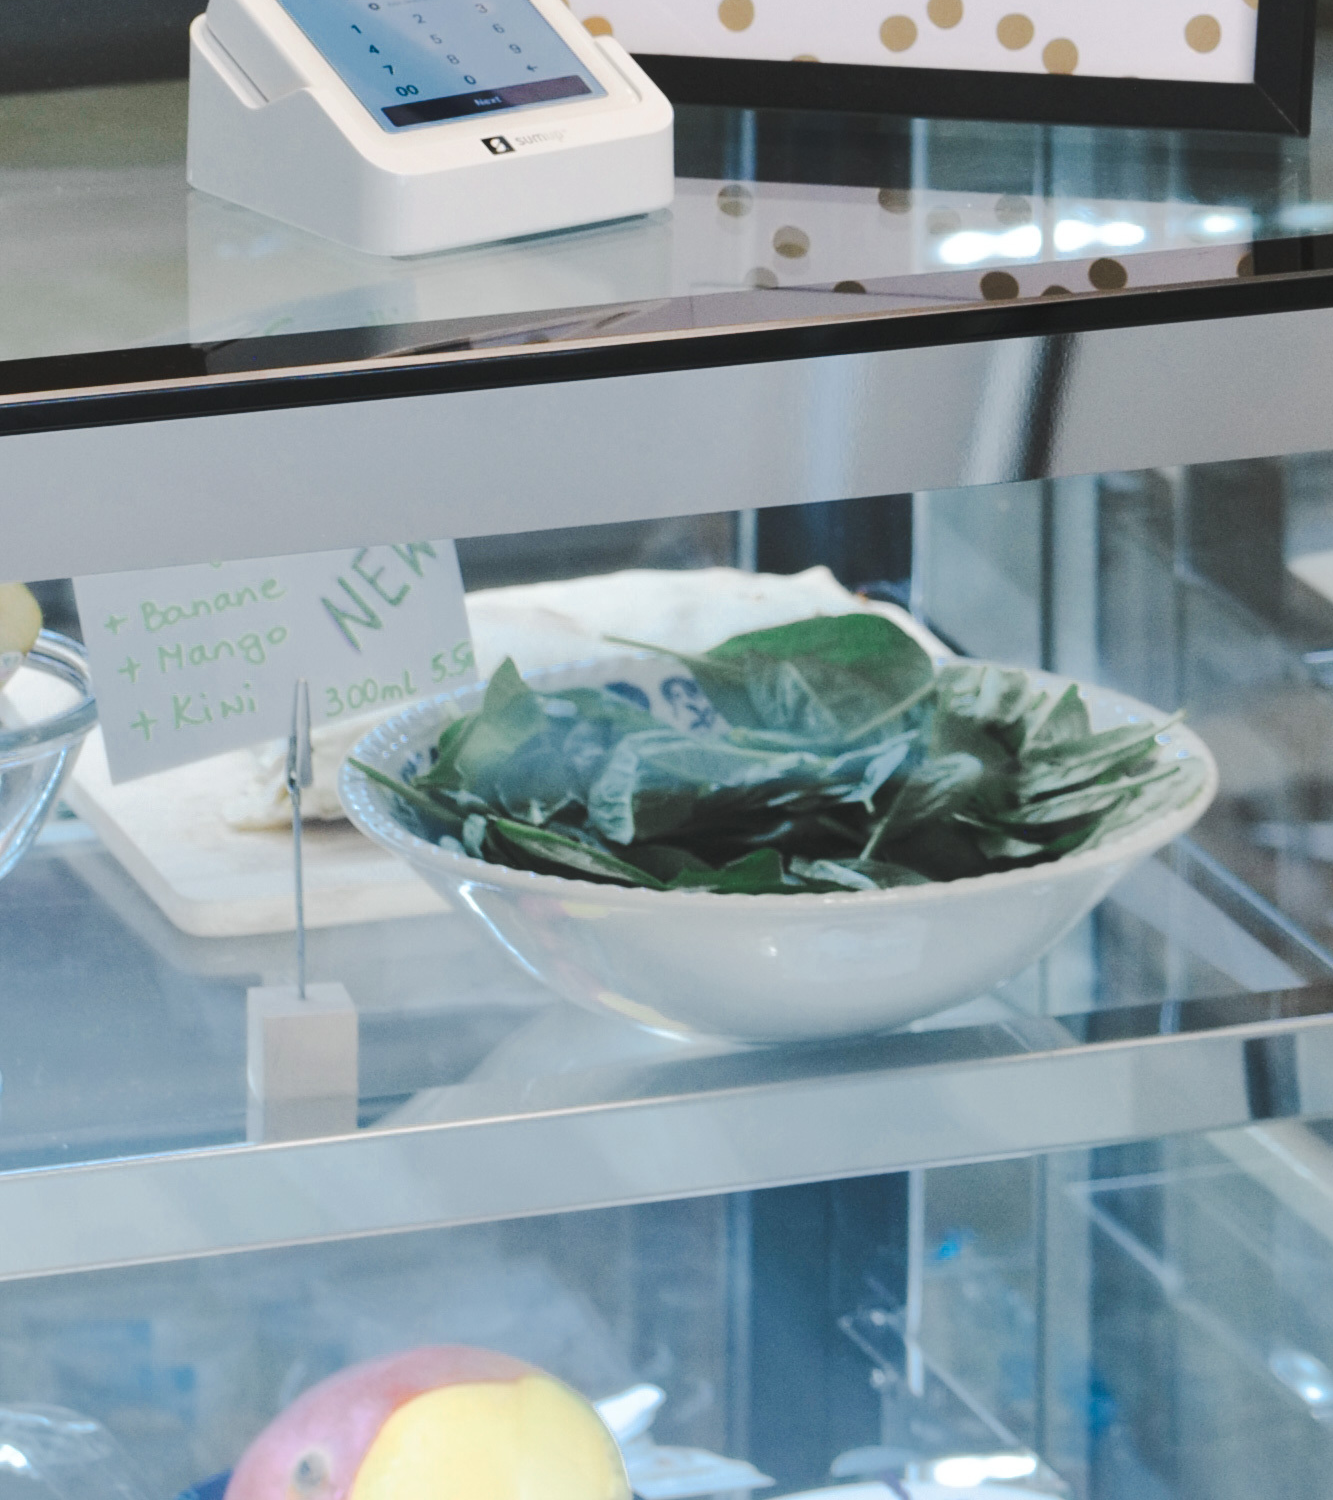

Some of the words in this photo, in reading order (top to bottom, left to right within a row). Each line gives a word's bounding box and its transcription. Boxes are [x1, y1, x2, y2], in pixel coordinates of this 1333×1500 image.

[351, 24, 362, 35] 1
[412, 13, 426, 25] 2
[475, 3, 488, 14] 3
[369, 44, 380, 55] 4
[430, 34, 443, 45] 5
[492, 23, 505, 34] 6
[383, 64, 394, 75] 7
[447, 54, 460, 66] 8
[509, 43, 522, 55] 9
[396, 84, 419, 97] 00
[463, 74, 477, 86] 0
[141, 578, 288, 632] Banane
[158, 626, 288, 673] Mango
[172, 682, 256, 730] Kiwi
